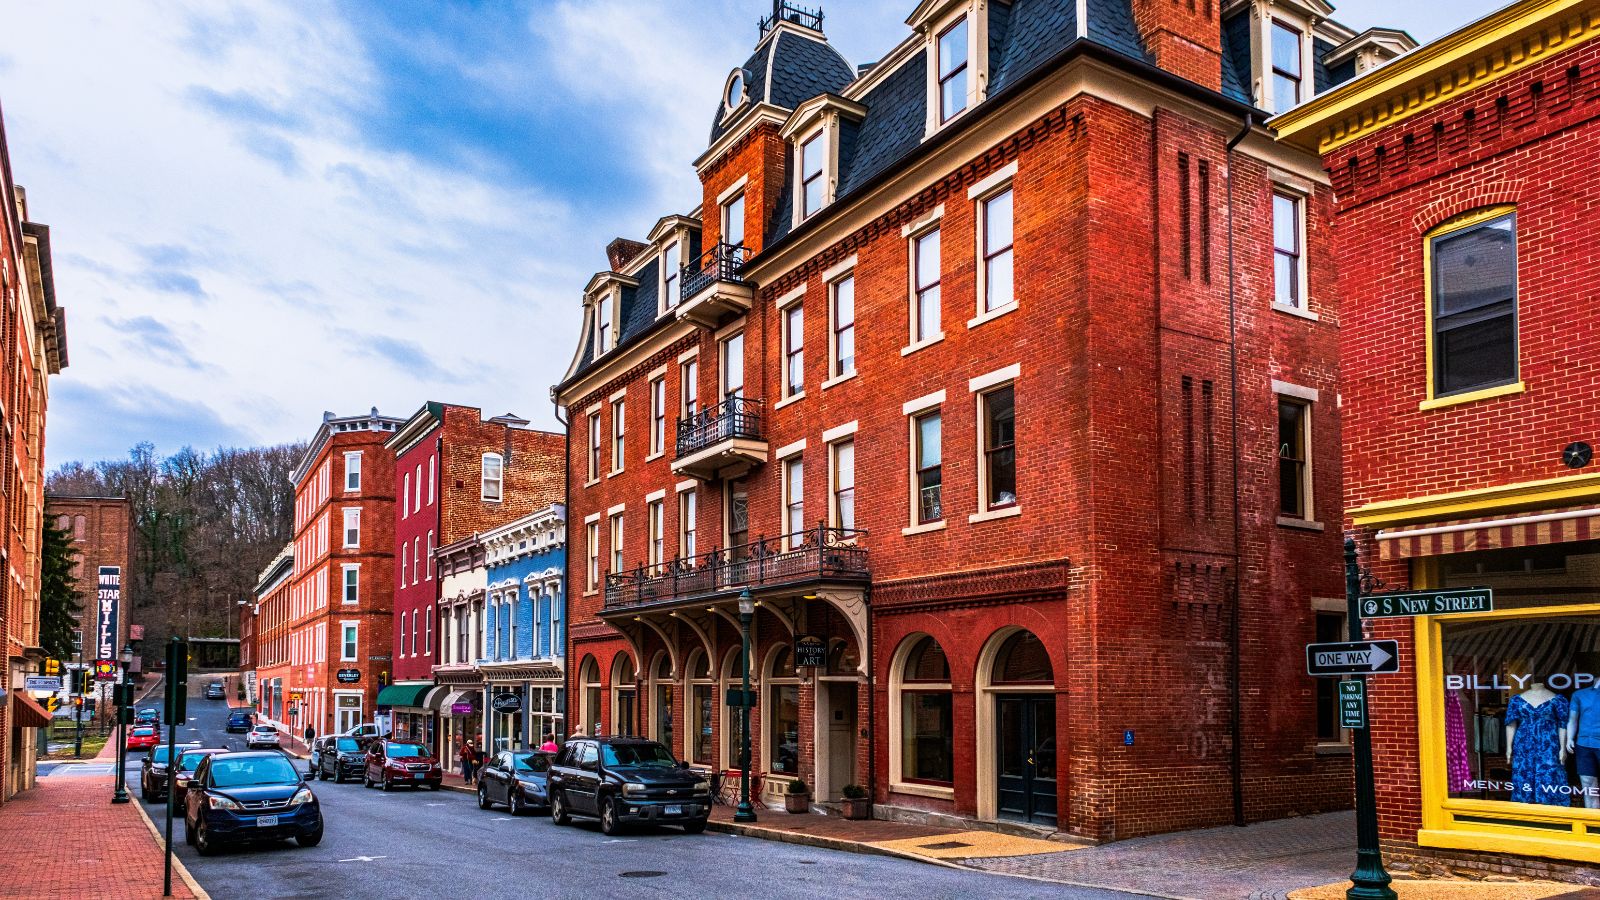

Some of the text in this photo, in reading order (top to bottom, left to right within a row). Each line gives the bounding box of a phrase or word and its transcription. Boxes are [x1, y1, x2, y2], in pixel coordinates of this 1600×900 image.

[98, 574, 120, 585] WHITE
[98, 589, 119, 599] STAR
[1383, 595, 1486, 615] S NEW STREET
[100, 600, 112, 659] MILLS
[803, 657, 820, 665] ART
[1318, 651, 1372, 665] ONE WAY
[1446, 674, 1532, 689] BILLY
[1345, 701, 1358, 709] ANY
[1463, 779, 1515, 791] MEN'S
[1522, 782, 1533, 792] &
